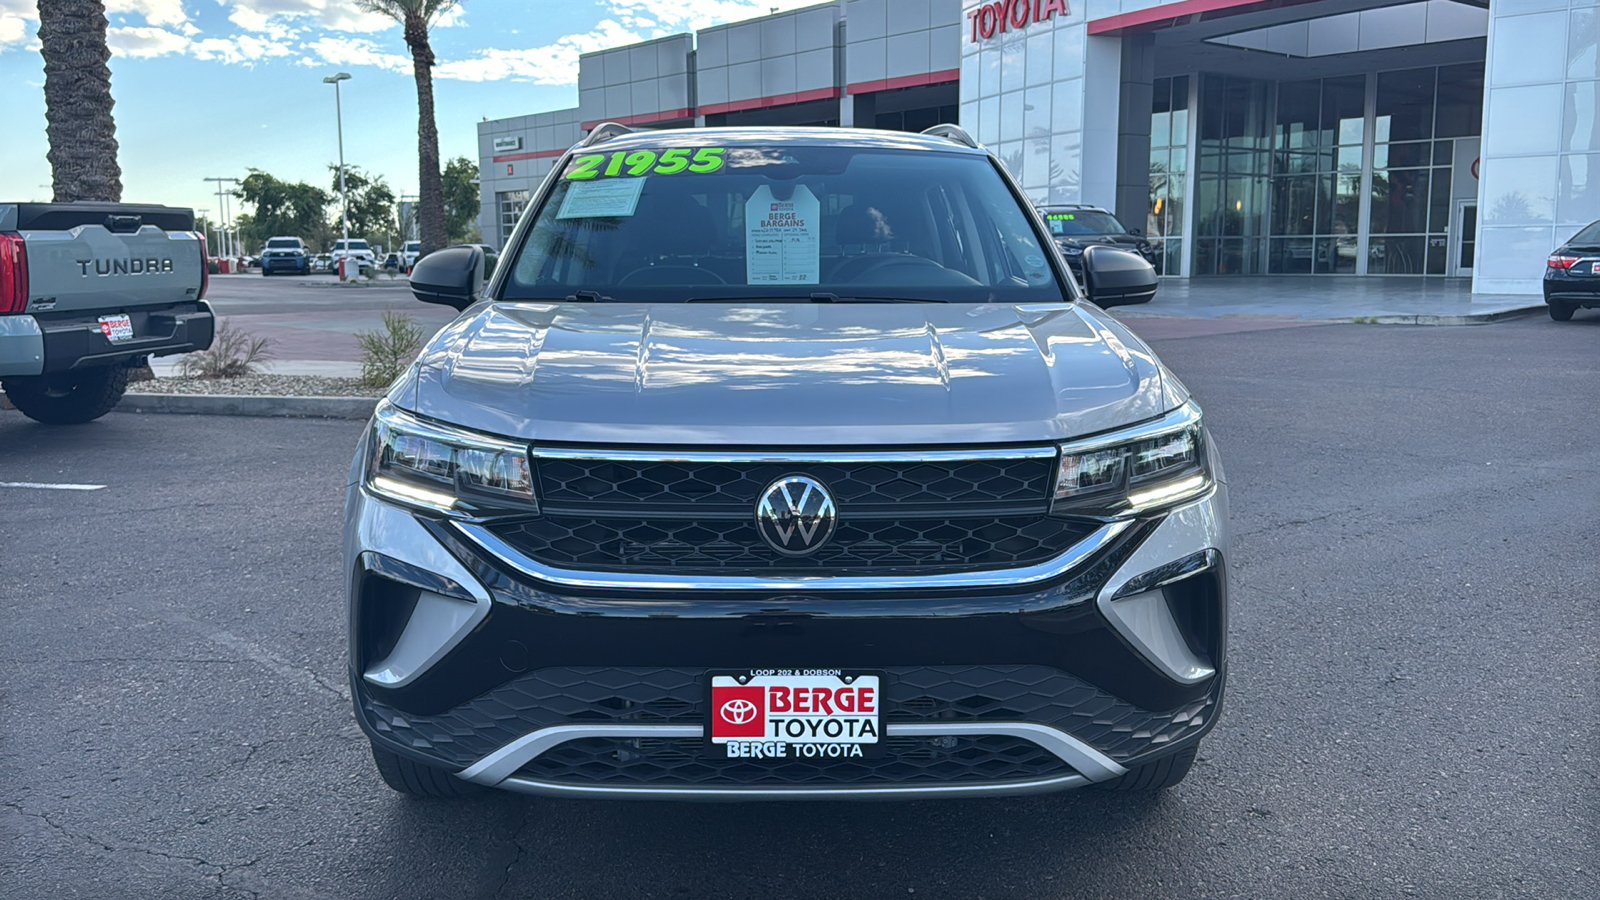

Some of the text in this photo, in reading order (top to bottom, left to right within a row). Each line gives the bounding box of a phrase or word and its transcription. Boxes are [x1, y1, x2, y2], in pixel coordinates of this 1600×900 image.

[565, 147, 727, 180] 21955
[760, 219, 805, 227] BARGAINS
[768, 212, 797, 220] BERGE
[76, 258, 174, 277] TUNDRA
[109, 319, 131, 329] BERGE
[768, 686, 875, 716] BERGE
[769, 718, 878, 738] TOYOTA
[726, 741, 863, 759] BERGE TOYOTA
